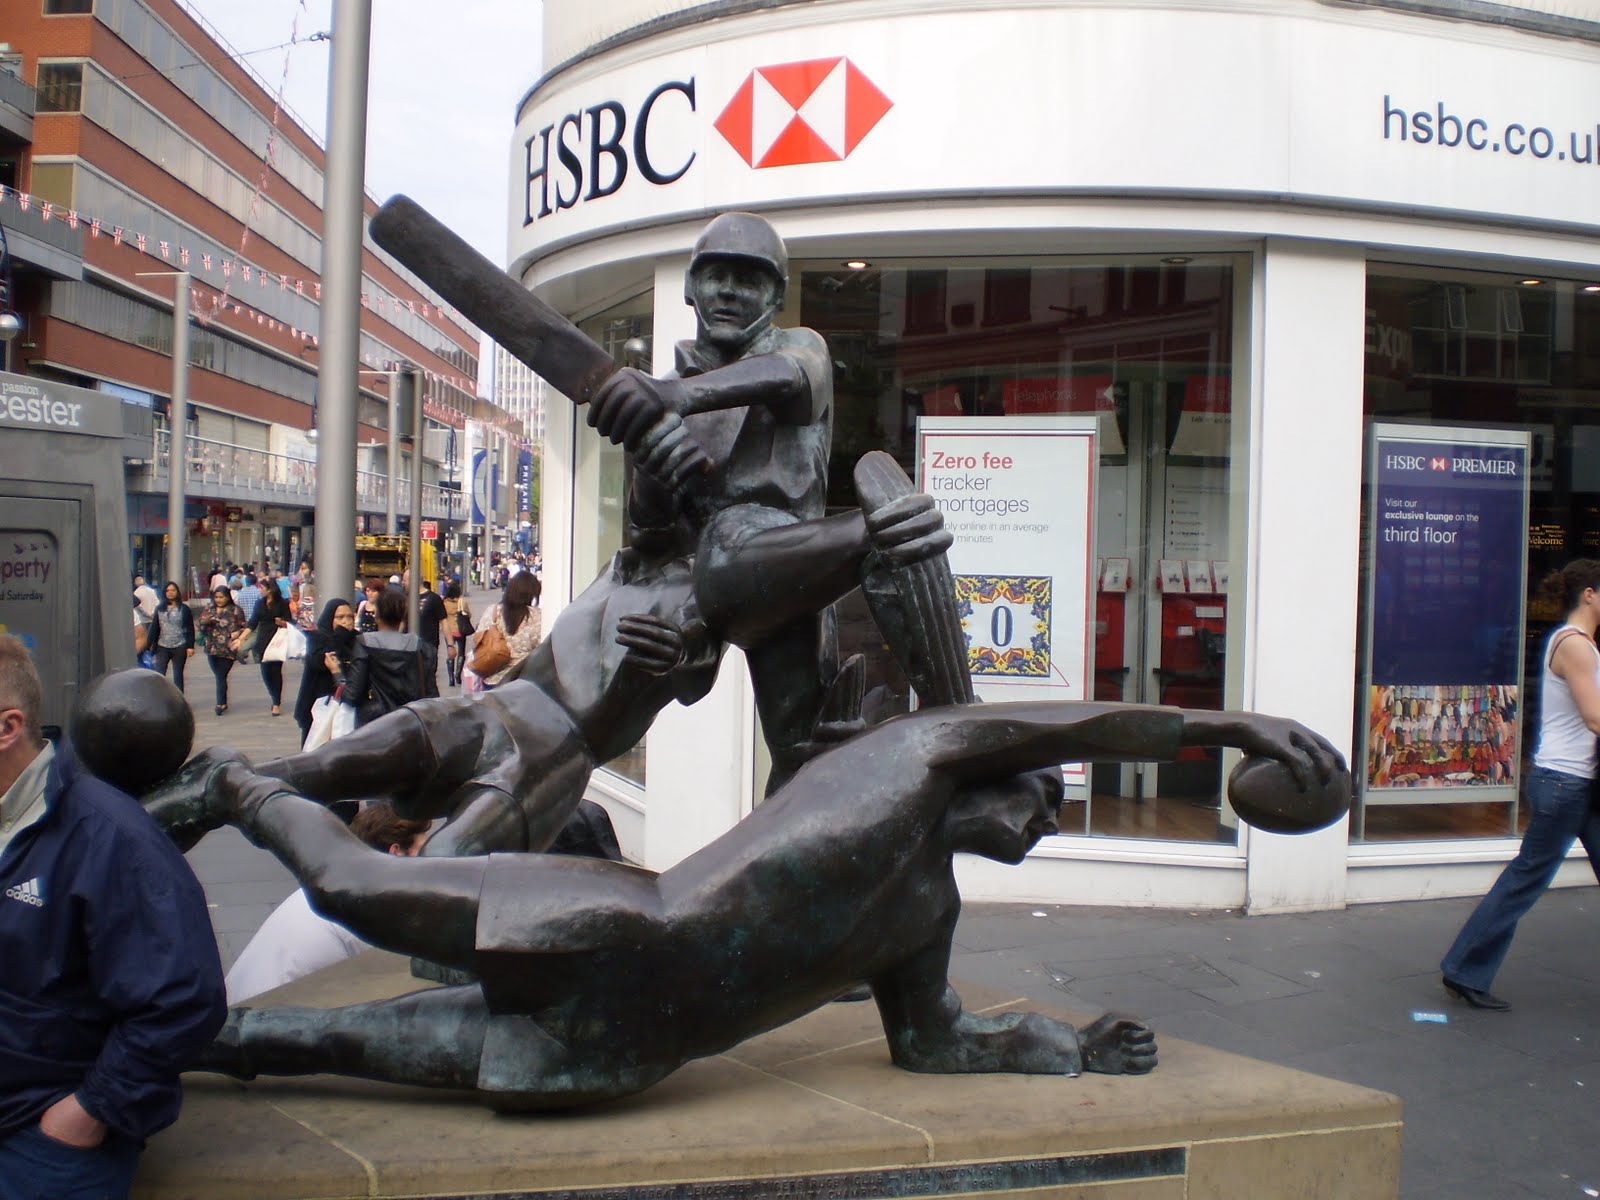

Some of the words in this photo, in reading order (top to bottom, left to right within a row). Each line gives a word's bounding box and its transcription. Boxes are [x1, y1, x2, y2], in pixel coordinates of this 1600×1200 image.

[523, 76, 697, 228] HSBC
[2, 382, 39, 396] passion
[0, 394, 81, 427] ester
[931, 451, 977, 469] Zero
[982, 451, 1013, 469] fee
[1386, 454, 1426, 471] HSBC
[1452, 457, 1516, 476] PREMIER
[931, 473, 992, 491] tracker
[933, 497, 1029, 516] mortgages
[1385, 498, 1403, 508] Visit
[1404, 500, 1418, 508] our
[1384, 510, 1425, 521] exclusive
[1425, 511, 1454, 523] lounge
[1455, 513, 1465, 522] on
[1466, 513, 1480, 522] the
[943, 521, 957, 532] ply
[959, 520, 987, 532] online
[988, 521, 997, 532] in
[999, 523, 1011, 532] an
[1012, 523, 1049, 534] average
[1385, 527, 1419, 543] third
[1424, 527, 1458, 544] floor
[956, 534, 994, 543] minutes
[1, 557, 51, 583] perty
[990, 605, 1014, 647] 0
[6, 888, 44, 907] adidas
